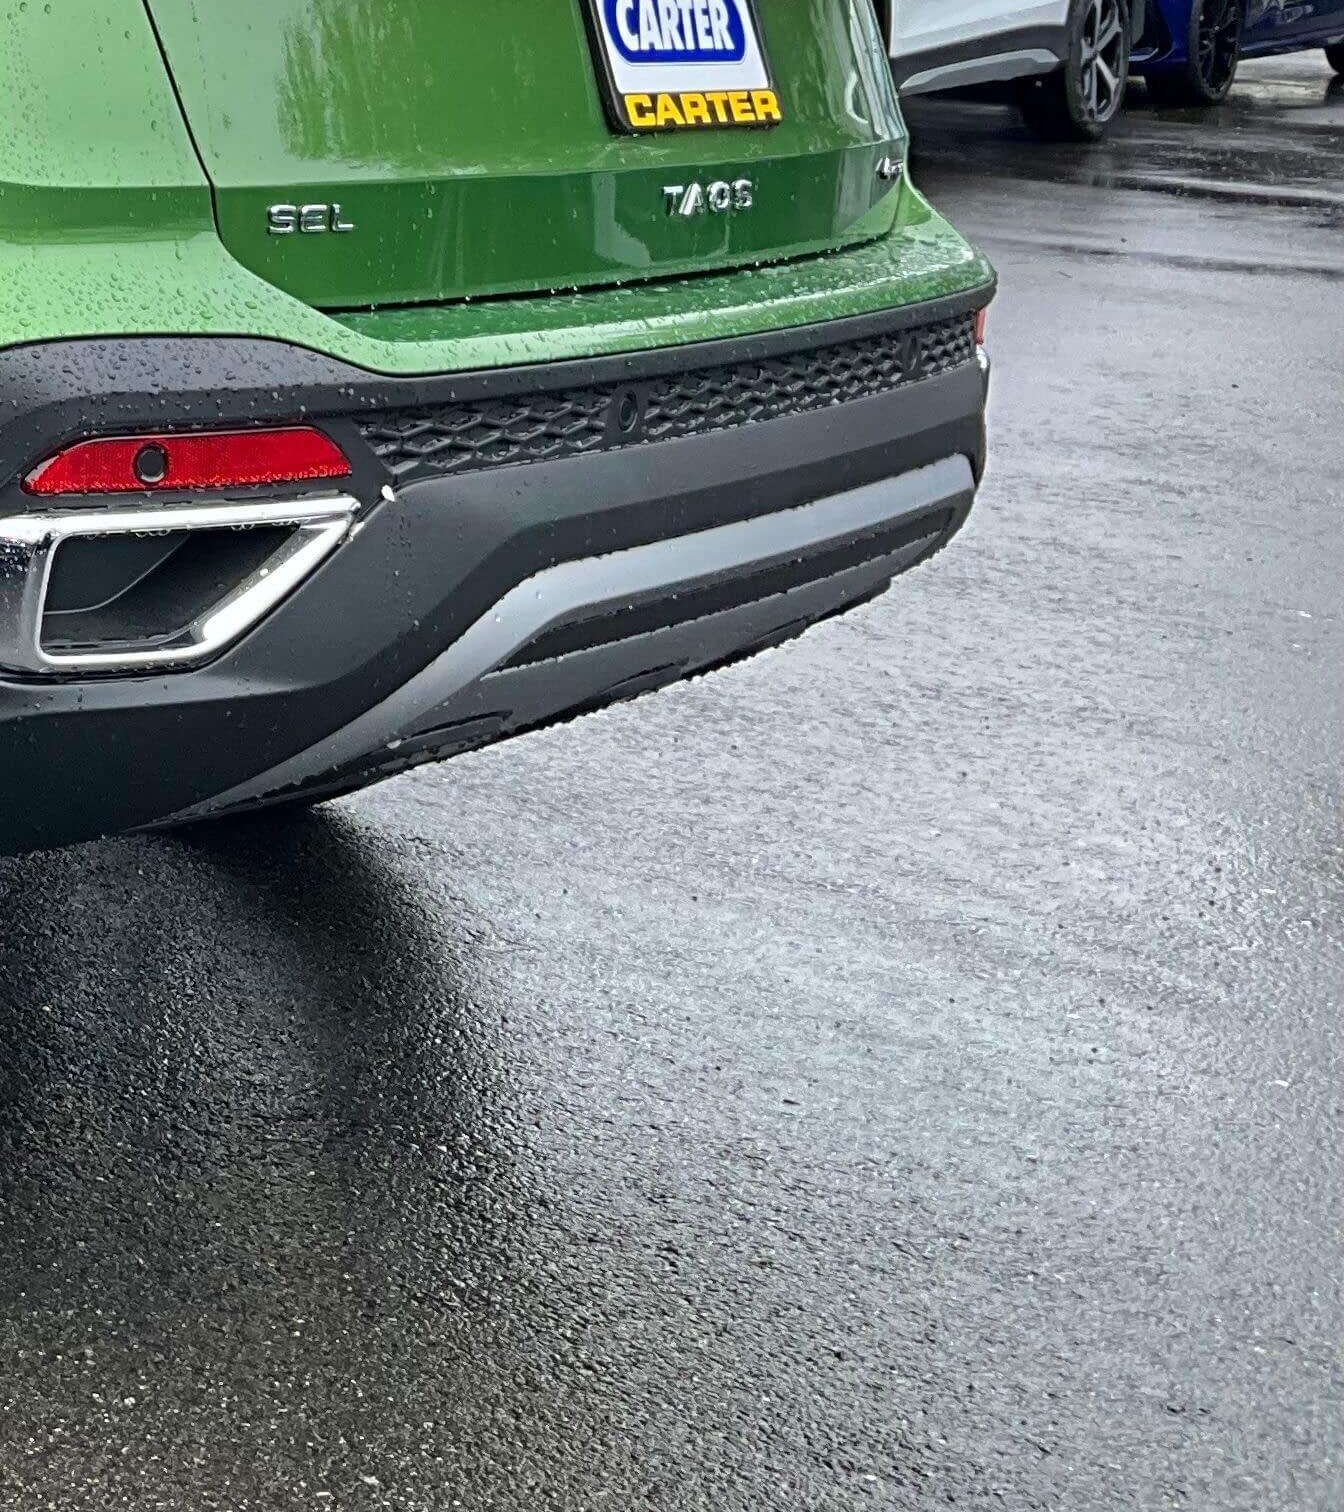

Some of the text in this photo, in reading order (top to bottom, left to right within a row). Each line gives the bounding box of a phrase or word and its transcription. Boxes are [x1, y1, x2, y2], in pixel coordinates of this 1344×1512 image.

[623, 90, 782, 127] CARTER
[663, 179, 754, 216] TAOS
[266, 202, 354, 235] SEL
